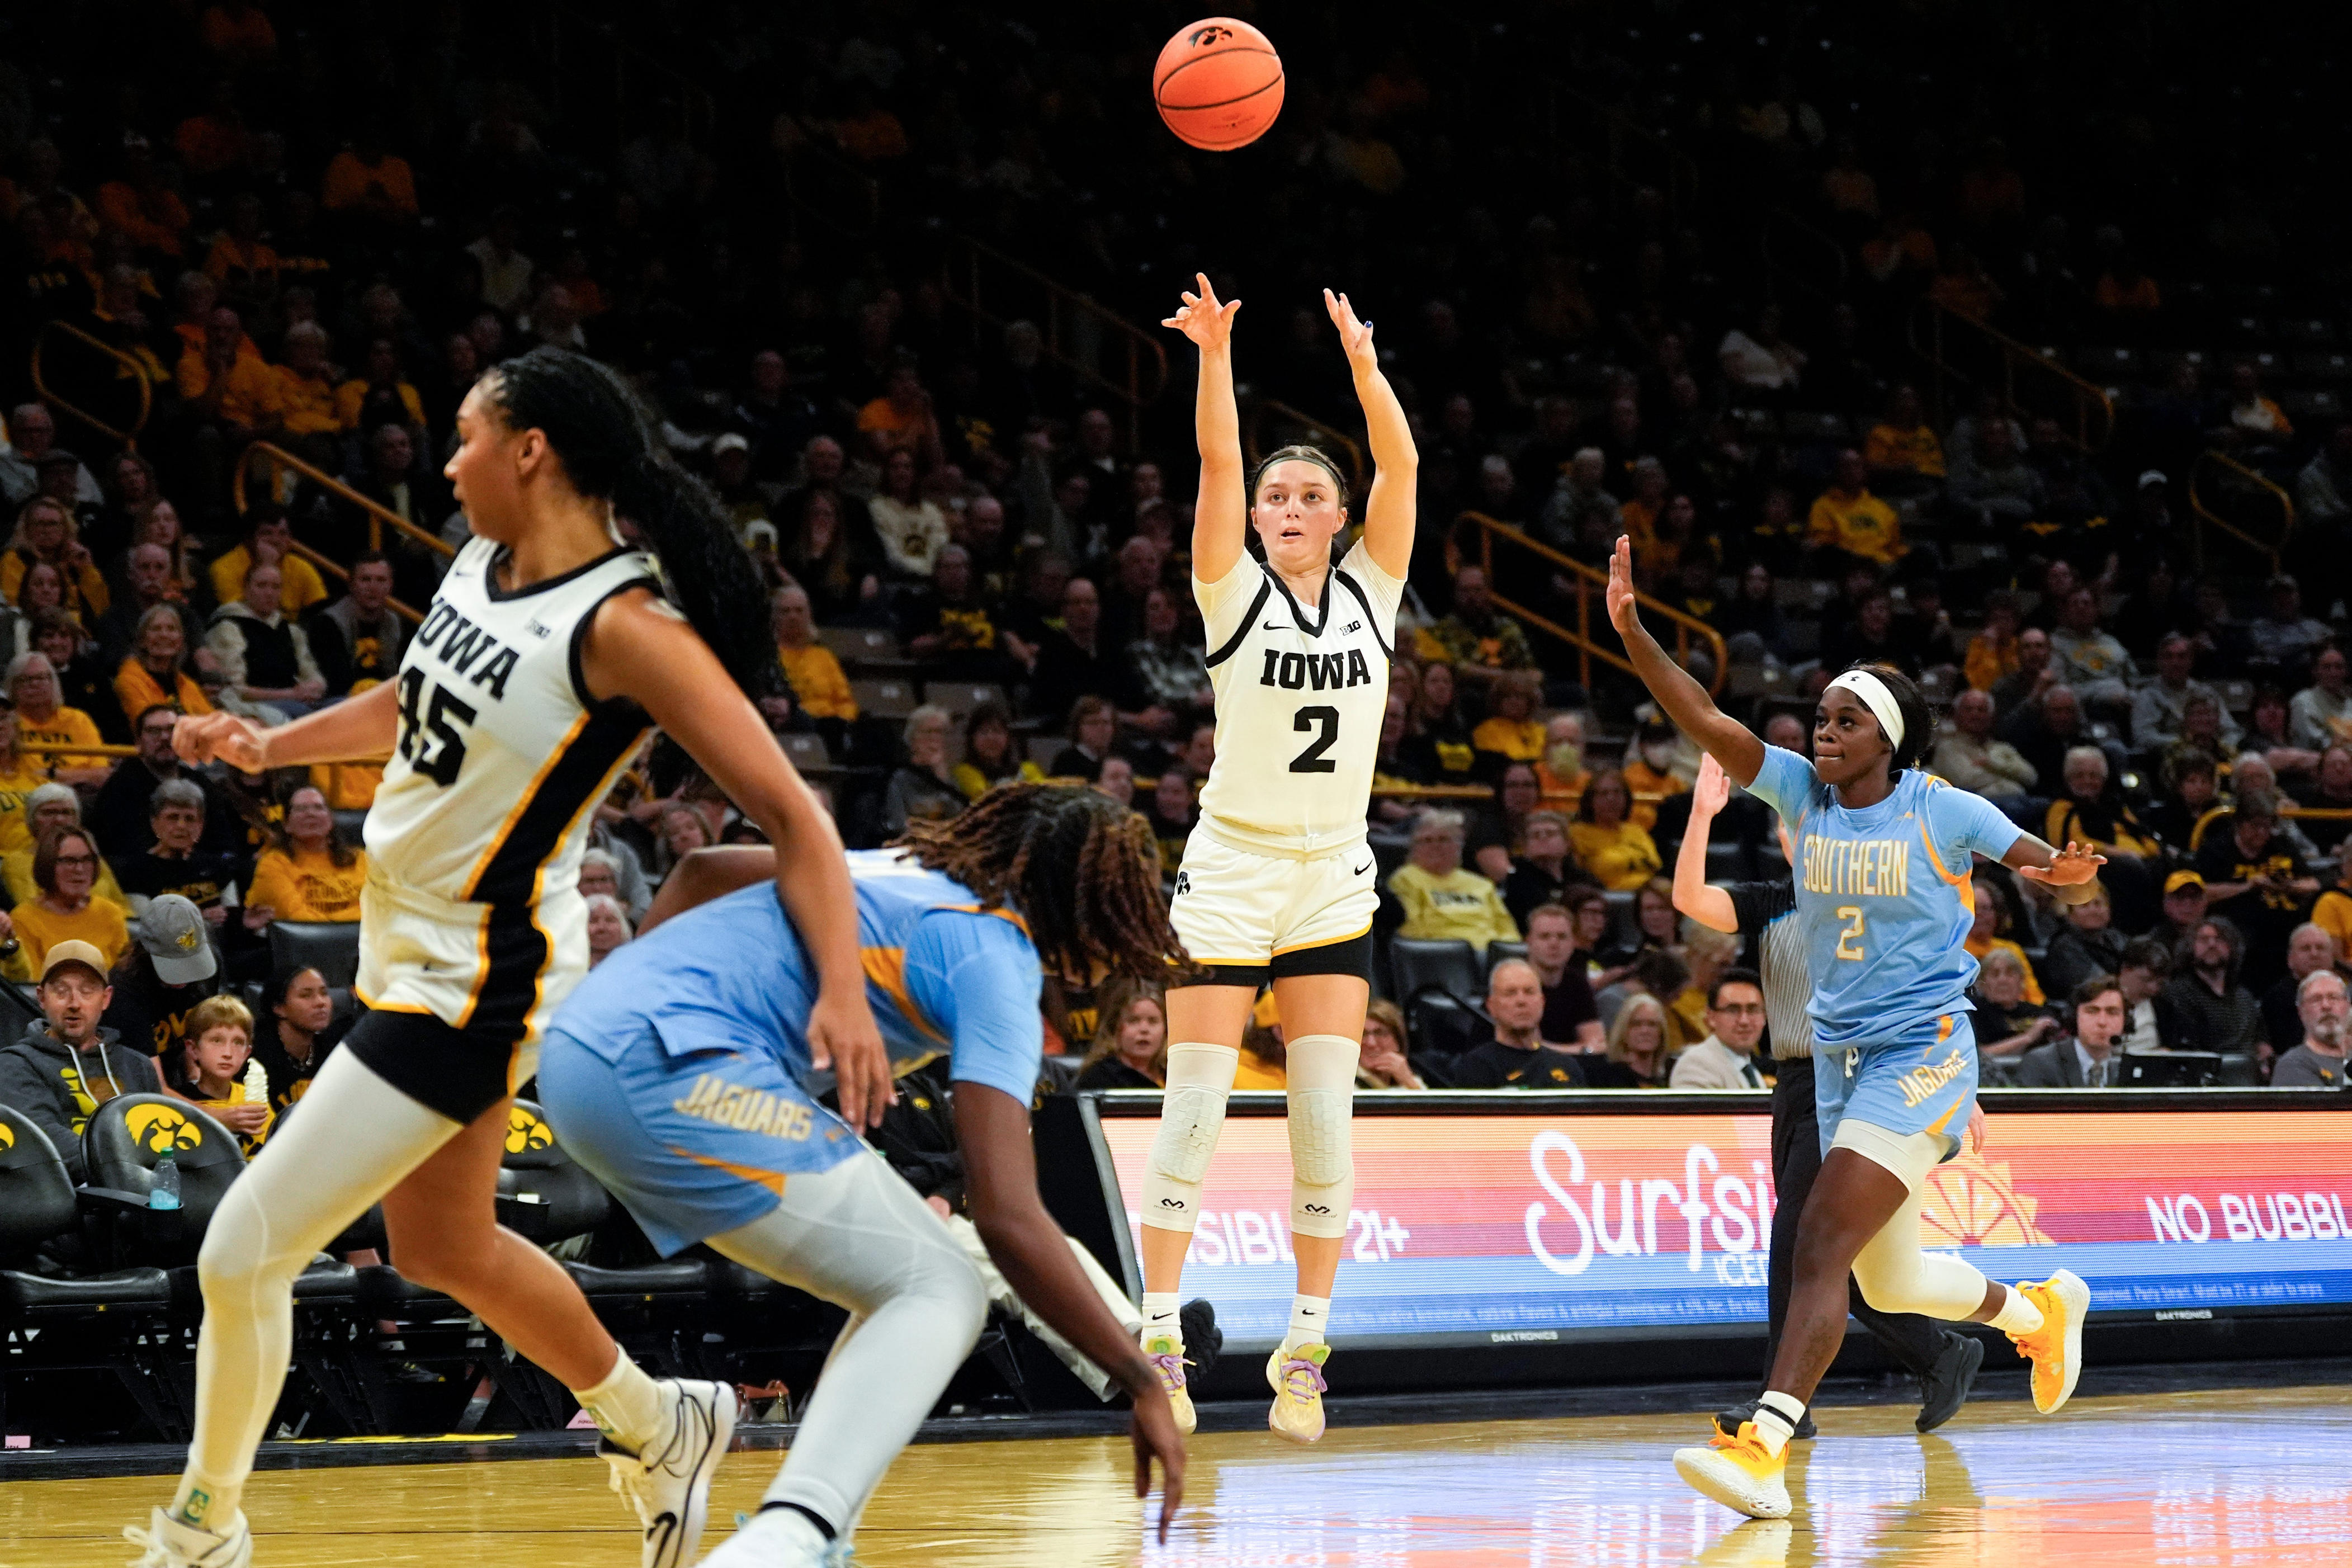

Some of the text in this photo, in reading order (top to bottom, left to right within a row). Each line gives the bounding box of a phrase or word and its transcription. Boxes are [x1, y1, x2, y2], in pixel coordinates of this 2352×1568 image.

[420, 597, 519, 703] OWA
[1260, 649, 1371, 691] IOWA
[1289, 706, 1339, 773] 2
[1803, 835, 1909, 896] SOUTHERN
[1836, 906, 1864, 961] 2
[674, 1074, 814, 1142] JAGUARS
[1525, 1130, 1778, 1274] Surfsi
[2145, 1192, 2352, 1244] NO BUBBL
[1347, 1210, 1411, 1263] 21+
[1490, 1330, 1558, 1343] DAKTRONICS
[2155, 1309, 2213, 1320] DAKTRONICS
